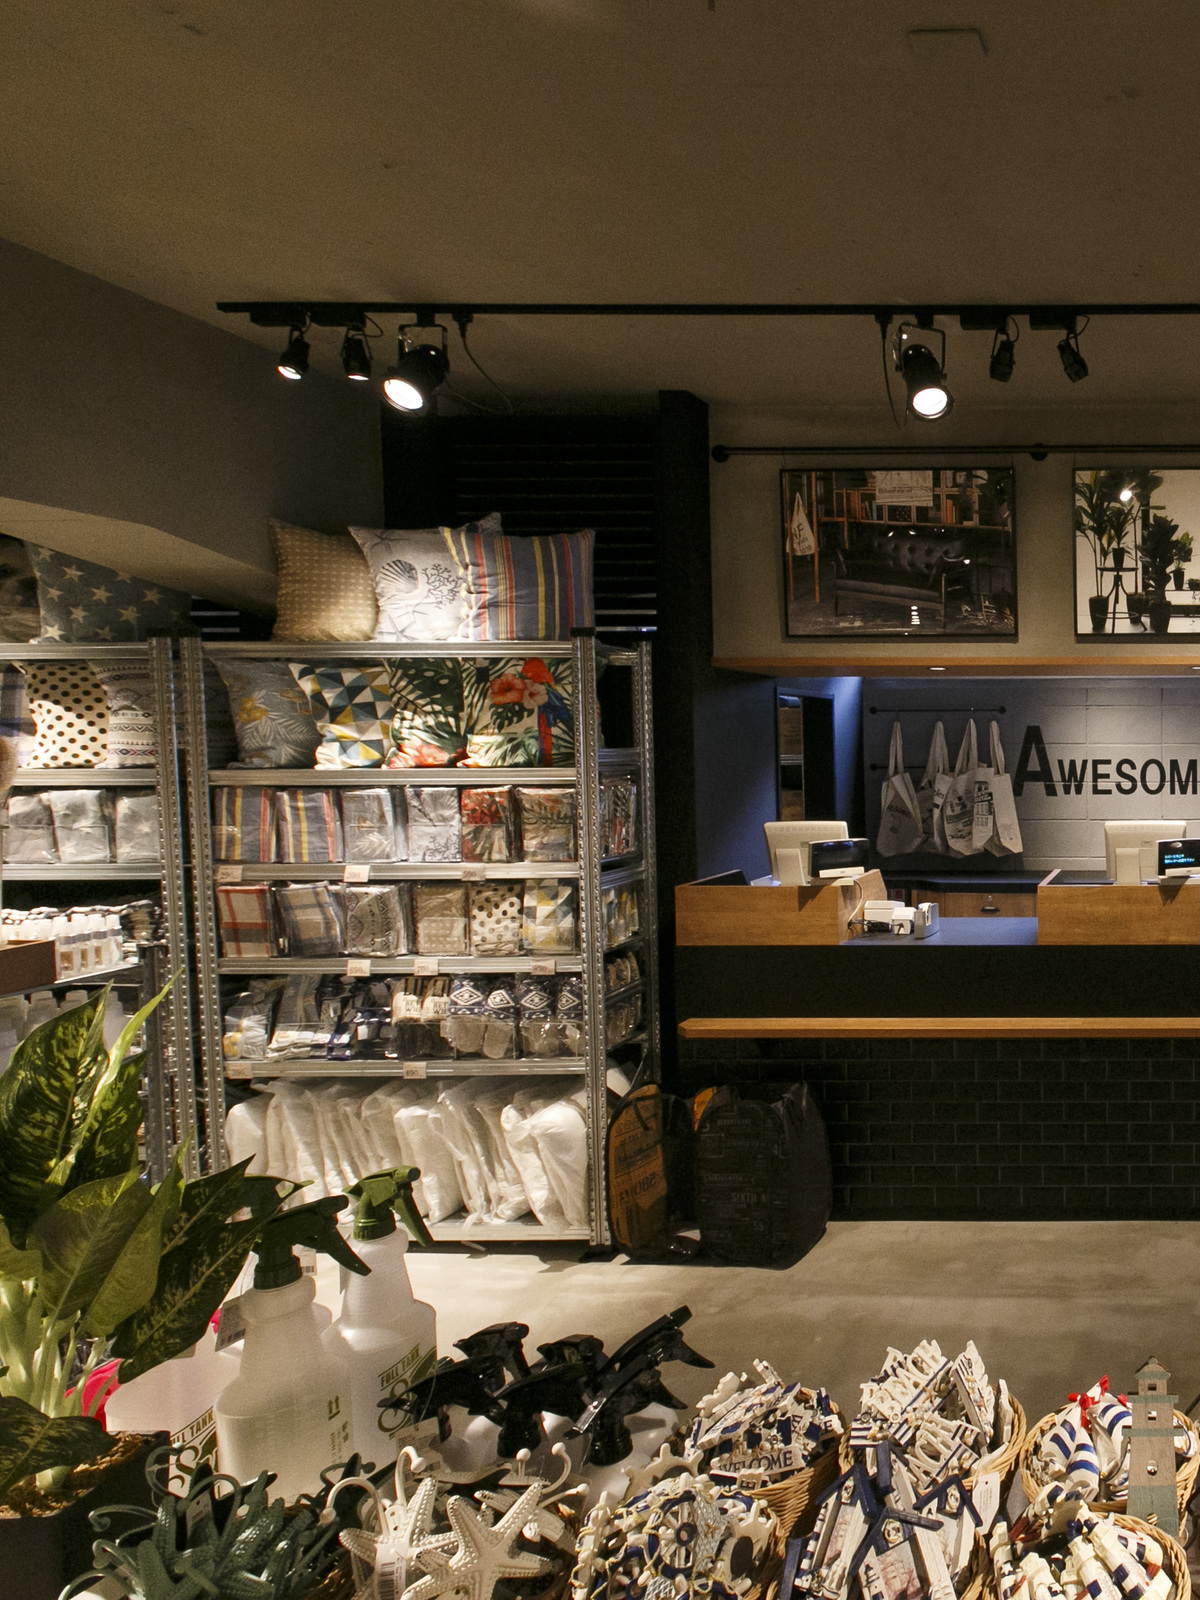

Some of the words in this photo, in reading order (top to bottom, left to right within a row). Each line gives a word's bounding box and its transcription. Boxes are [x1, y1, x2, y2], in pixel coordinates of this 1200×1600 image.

[380, 1367, 399, 1388] FULL
[401, 1346, 420, 1369] TANK
[189, 1409, 214, 1438] TANK
